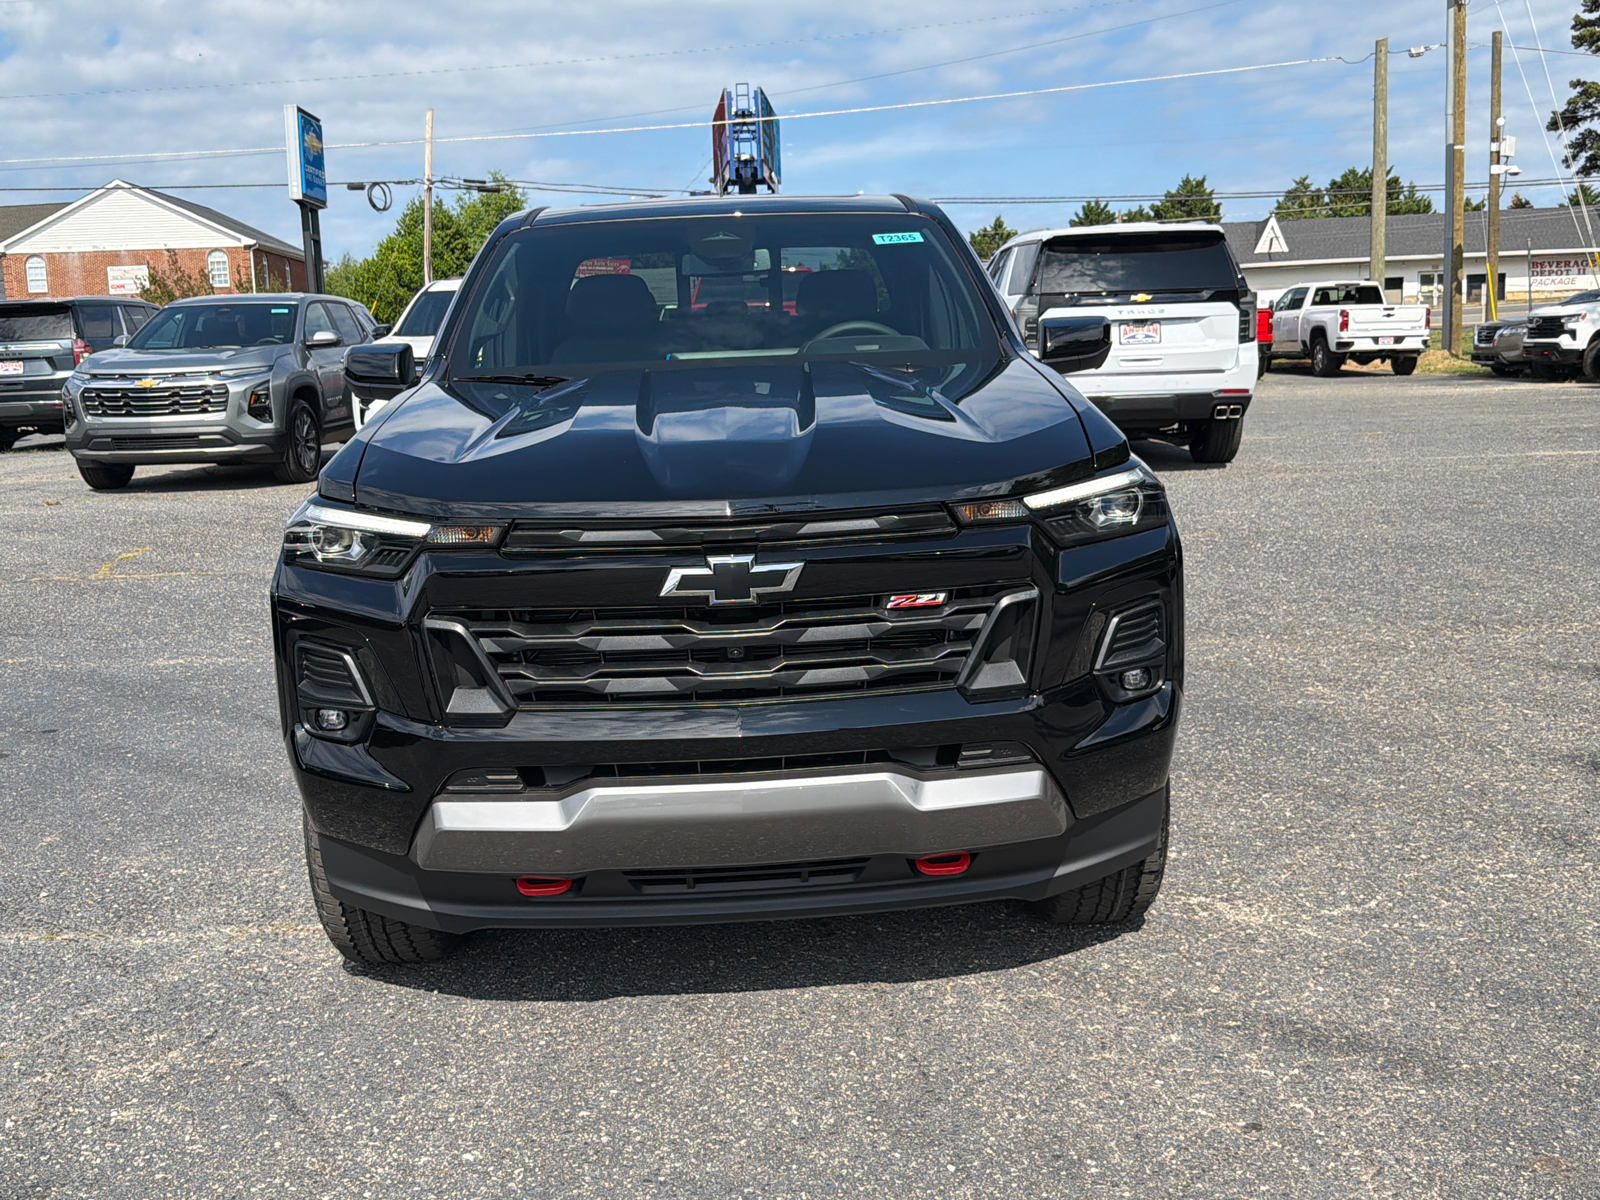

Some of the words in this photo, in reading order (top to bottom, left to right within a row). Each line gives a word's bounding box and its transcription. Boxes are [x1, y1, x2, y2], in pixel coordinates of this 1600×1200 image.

[878, 233, 916, 242] T2365
[1531, 259, 1598, 270] BEVERAGE
[1531, 268, 1572, 277] DEPOT
[1531, 277, 1578, 287] PACKAGE
[886, 592, 946, 608] Z71
